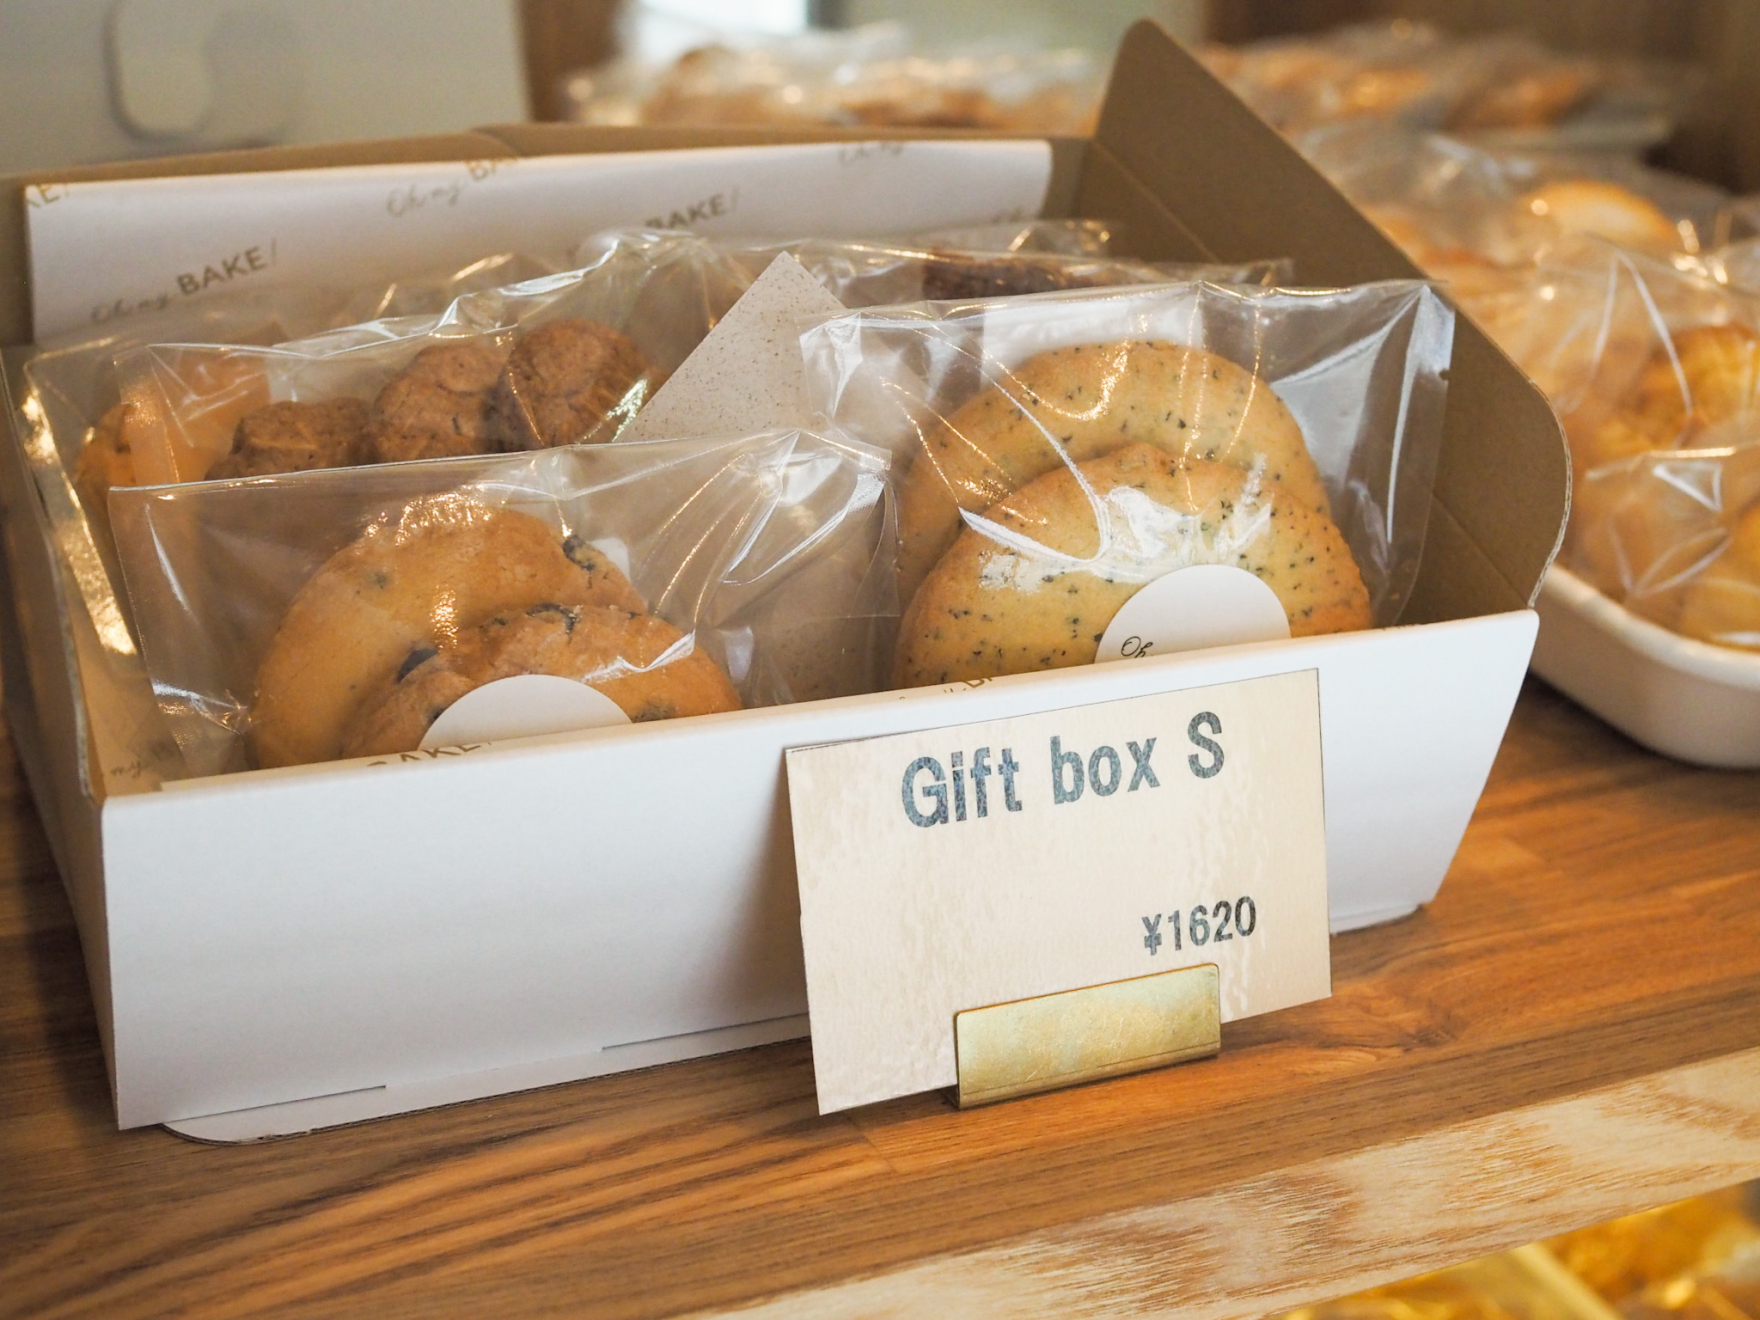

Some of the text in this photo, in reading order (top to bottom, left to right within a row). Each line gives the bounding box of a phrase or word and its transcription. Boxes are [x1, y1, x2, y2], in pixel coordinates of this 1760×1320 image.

[901, 711, 1225, 829] Gift box S
[1141, 895, 1257, 956] ¥1620
